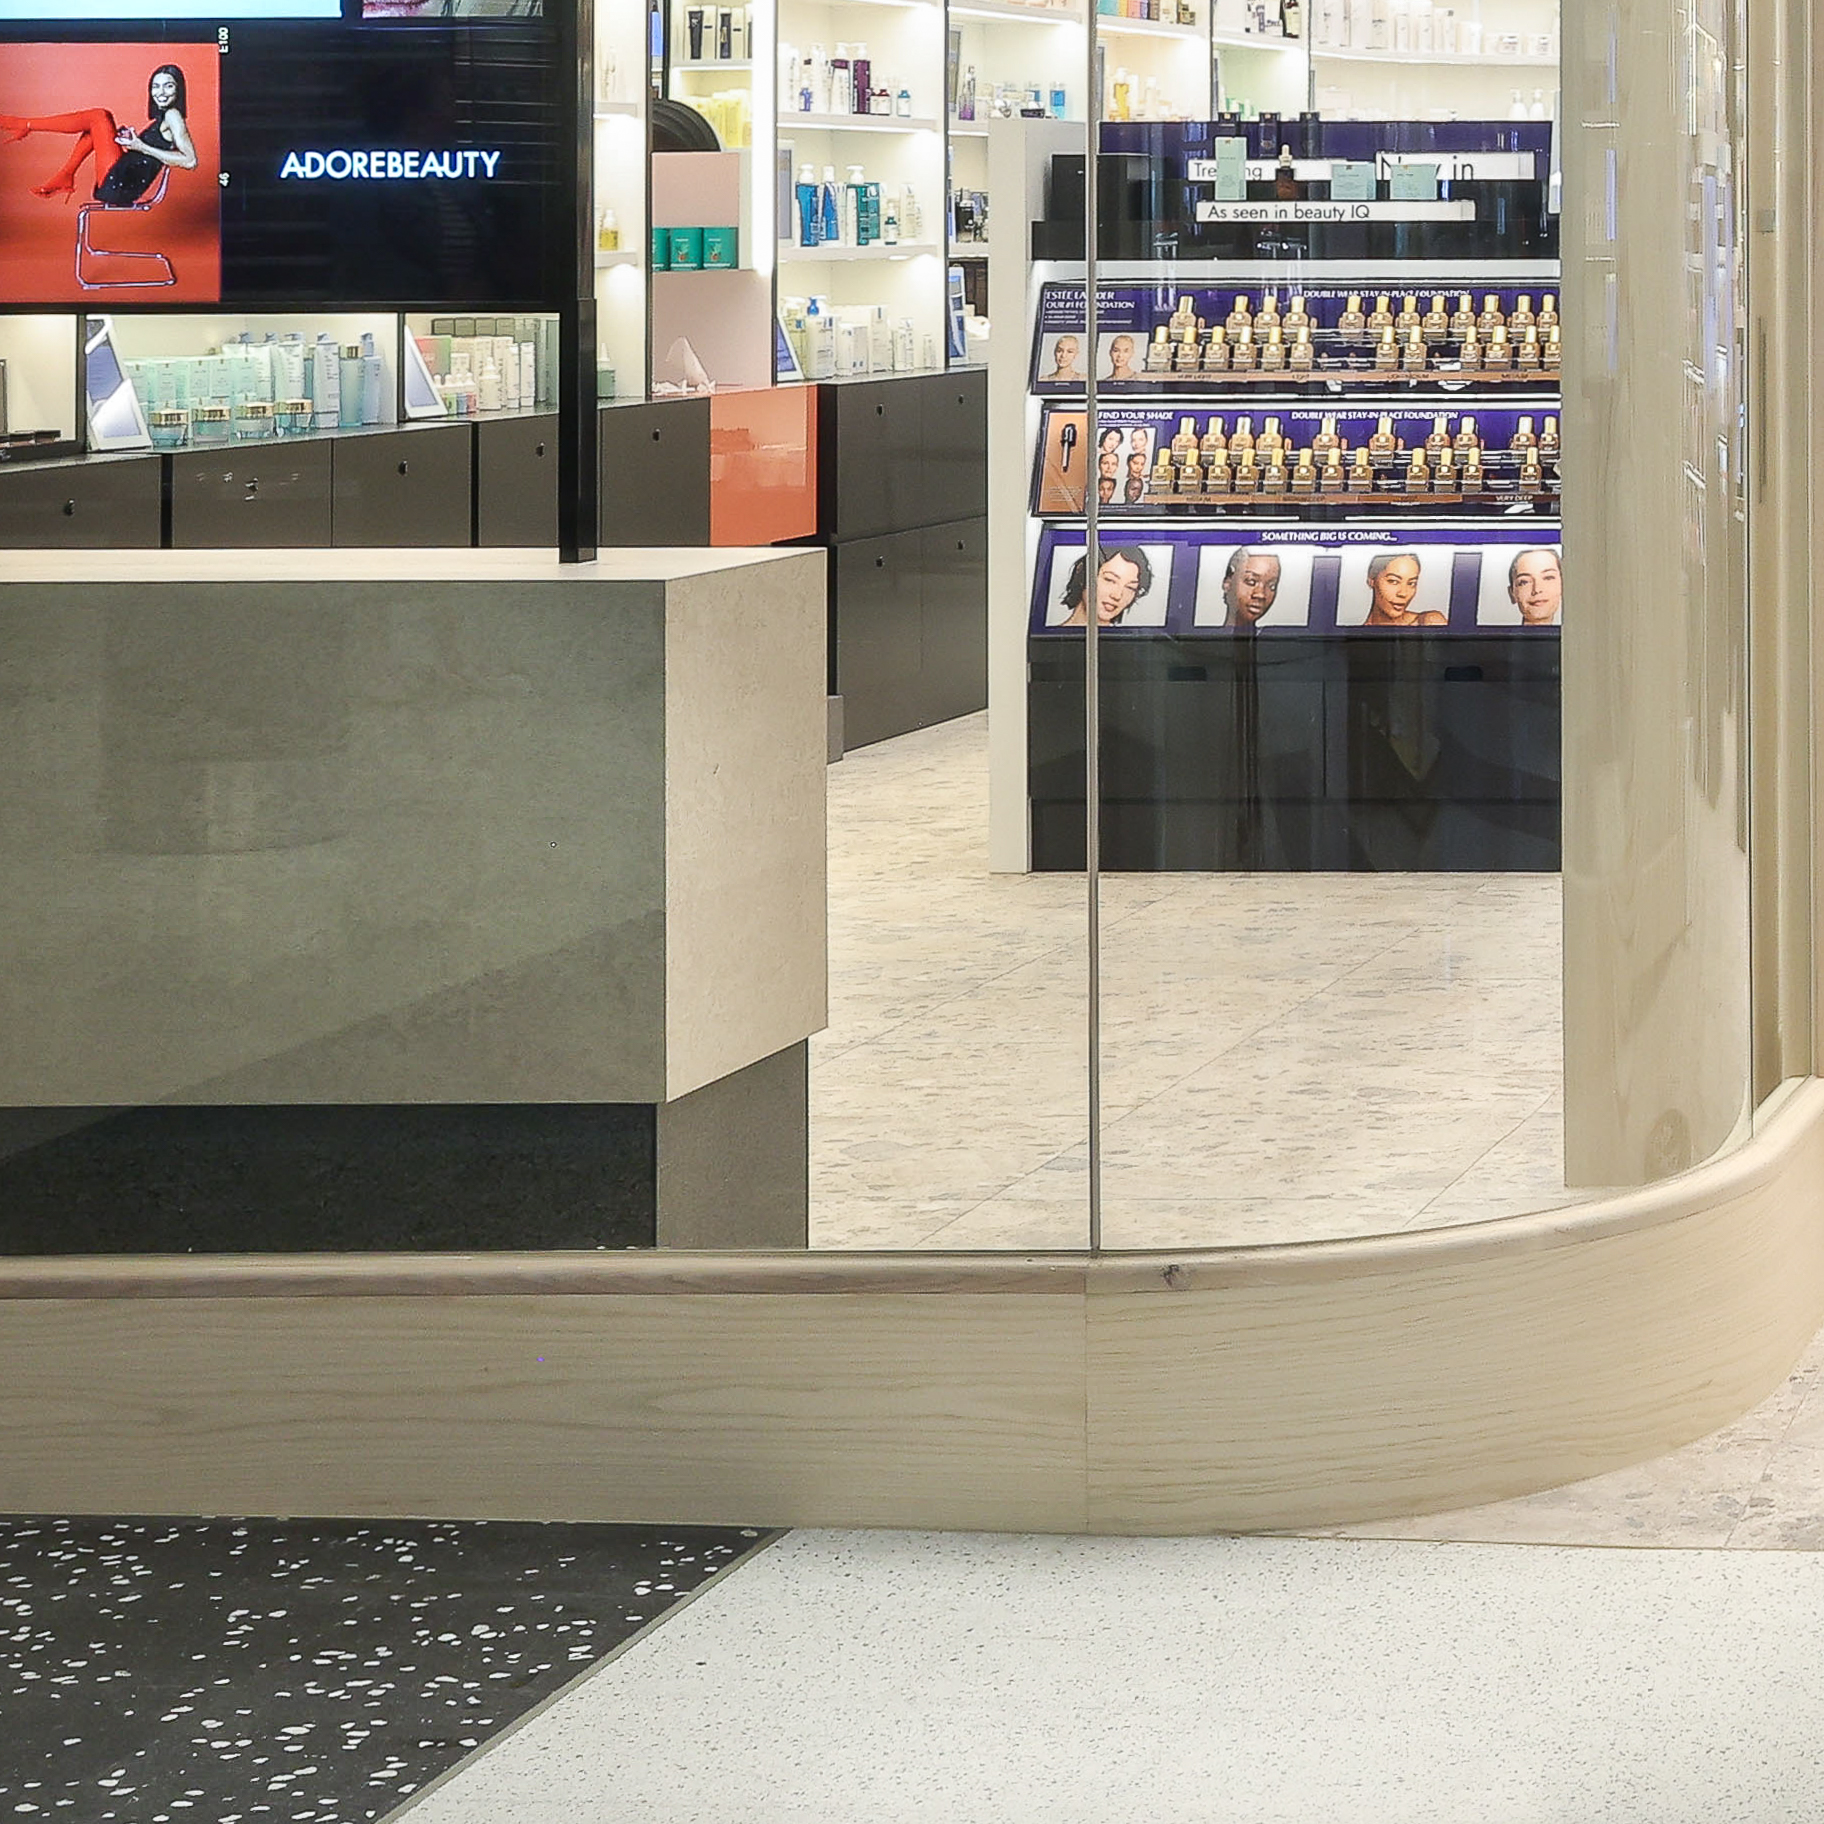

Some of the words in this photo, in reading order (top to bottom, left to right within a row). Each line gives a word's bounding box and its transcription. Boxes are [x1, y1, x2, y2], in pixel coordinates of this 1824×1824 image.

[280, 150, 500, 178] ADOREBEAUTY
[1194, 163, 1262, 180] Treng
[1208, 205, 1227, 219] As
[1232, 208, 1268, 219] seen
[1274, 205, 1287, 219] in
[1294, 205, 1345, 222] beauty
[1351, 205, 1370, 219] IQ
[1075, 301, 1136, 309] FONDATION
[1098, 412, 1119, 420] FIND
[1120, 412, 1145, 420] YOUR
[1146, 412, 1173, 420] SHADE
[1262, 531, 1319, 541] SOMETHING
[1320, 531, 1336, 541] BIG
[1338, 531, 1347, 541] IS
